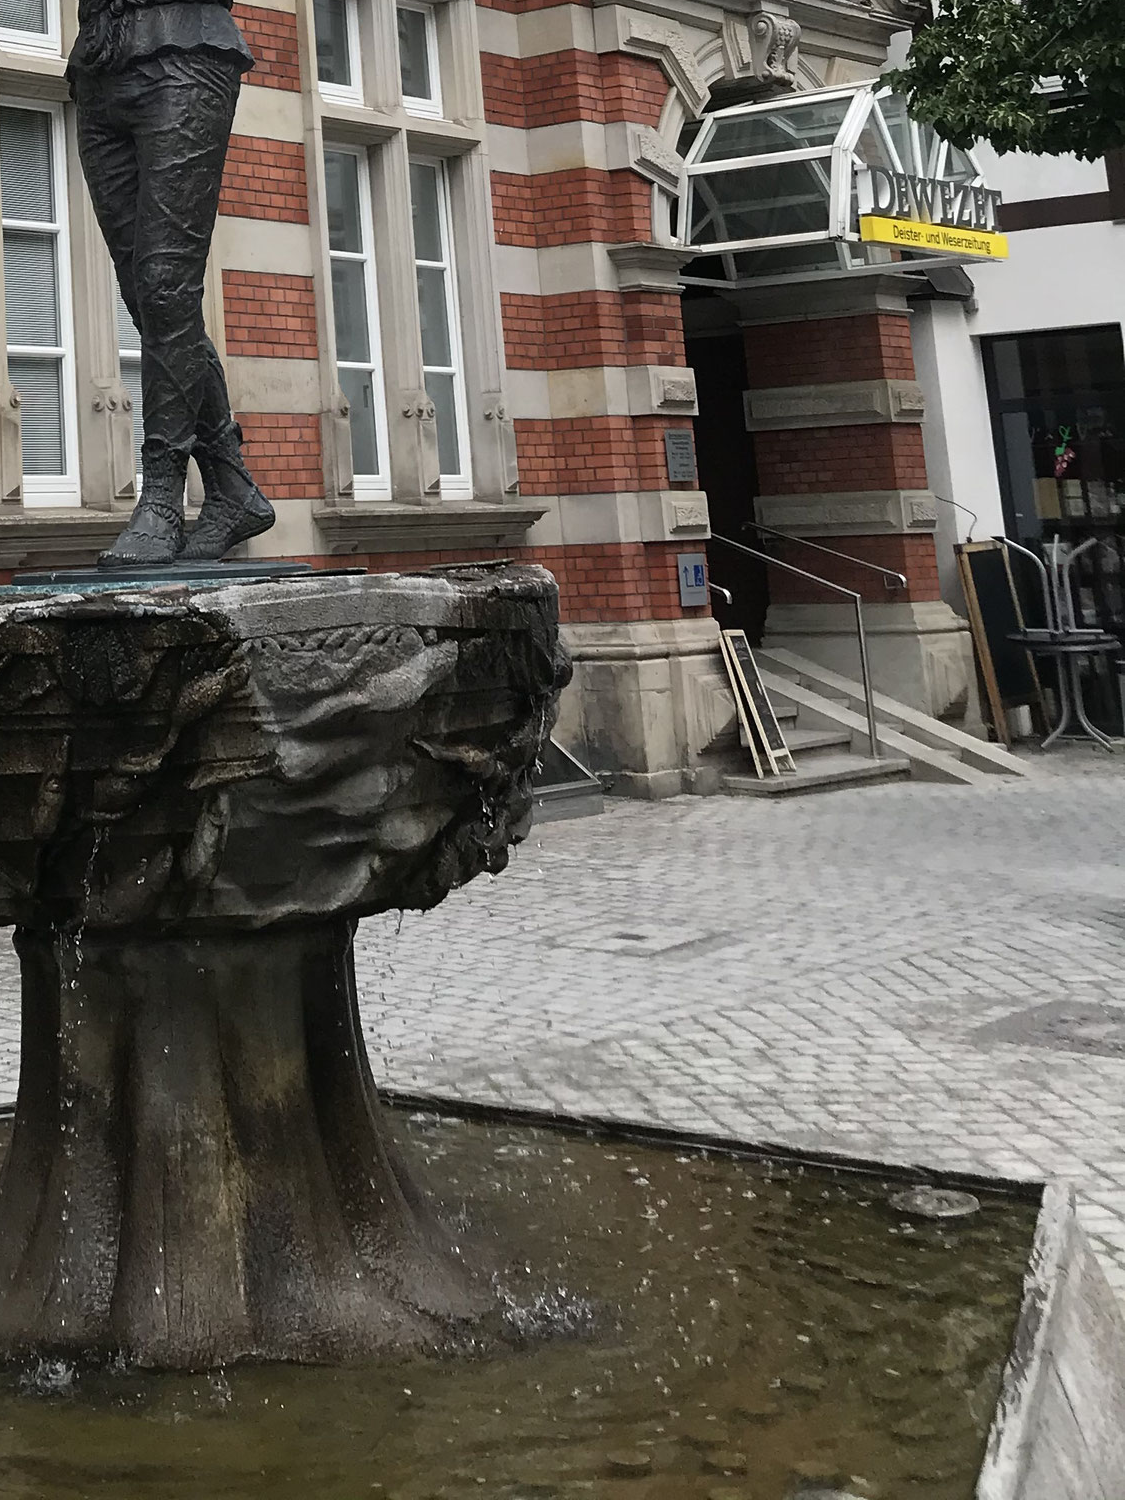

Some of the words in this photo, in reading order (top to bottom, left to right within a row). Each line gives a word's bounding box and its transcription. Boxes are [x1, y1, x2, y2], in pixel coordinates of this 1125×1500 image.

[867, 164, 1003, 233] DEWEZET
[892, 224, 924, 242] Deister-
[926, 231, 940, 245] und
[941, 232, 991, 255] Weserzeitung
